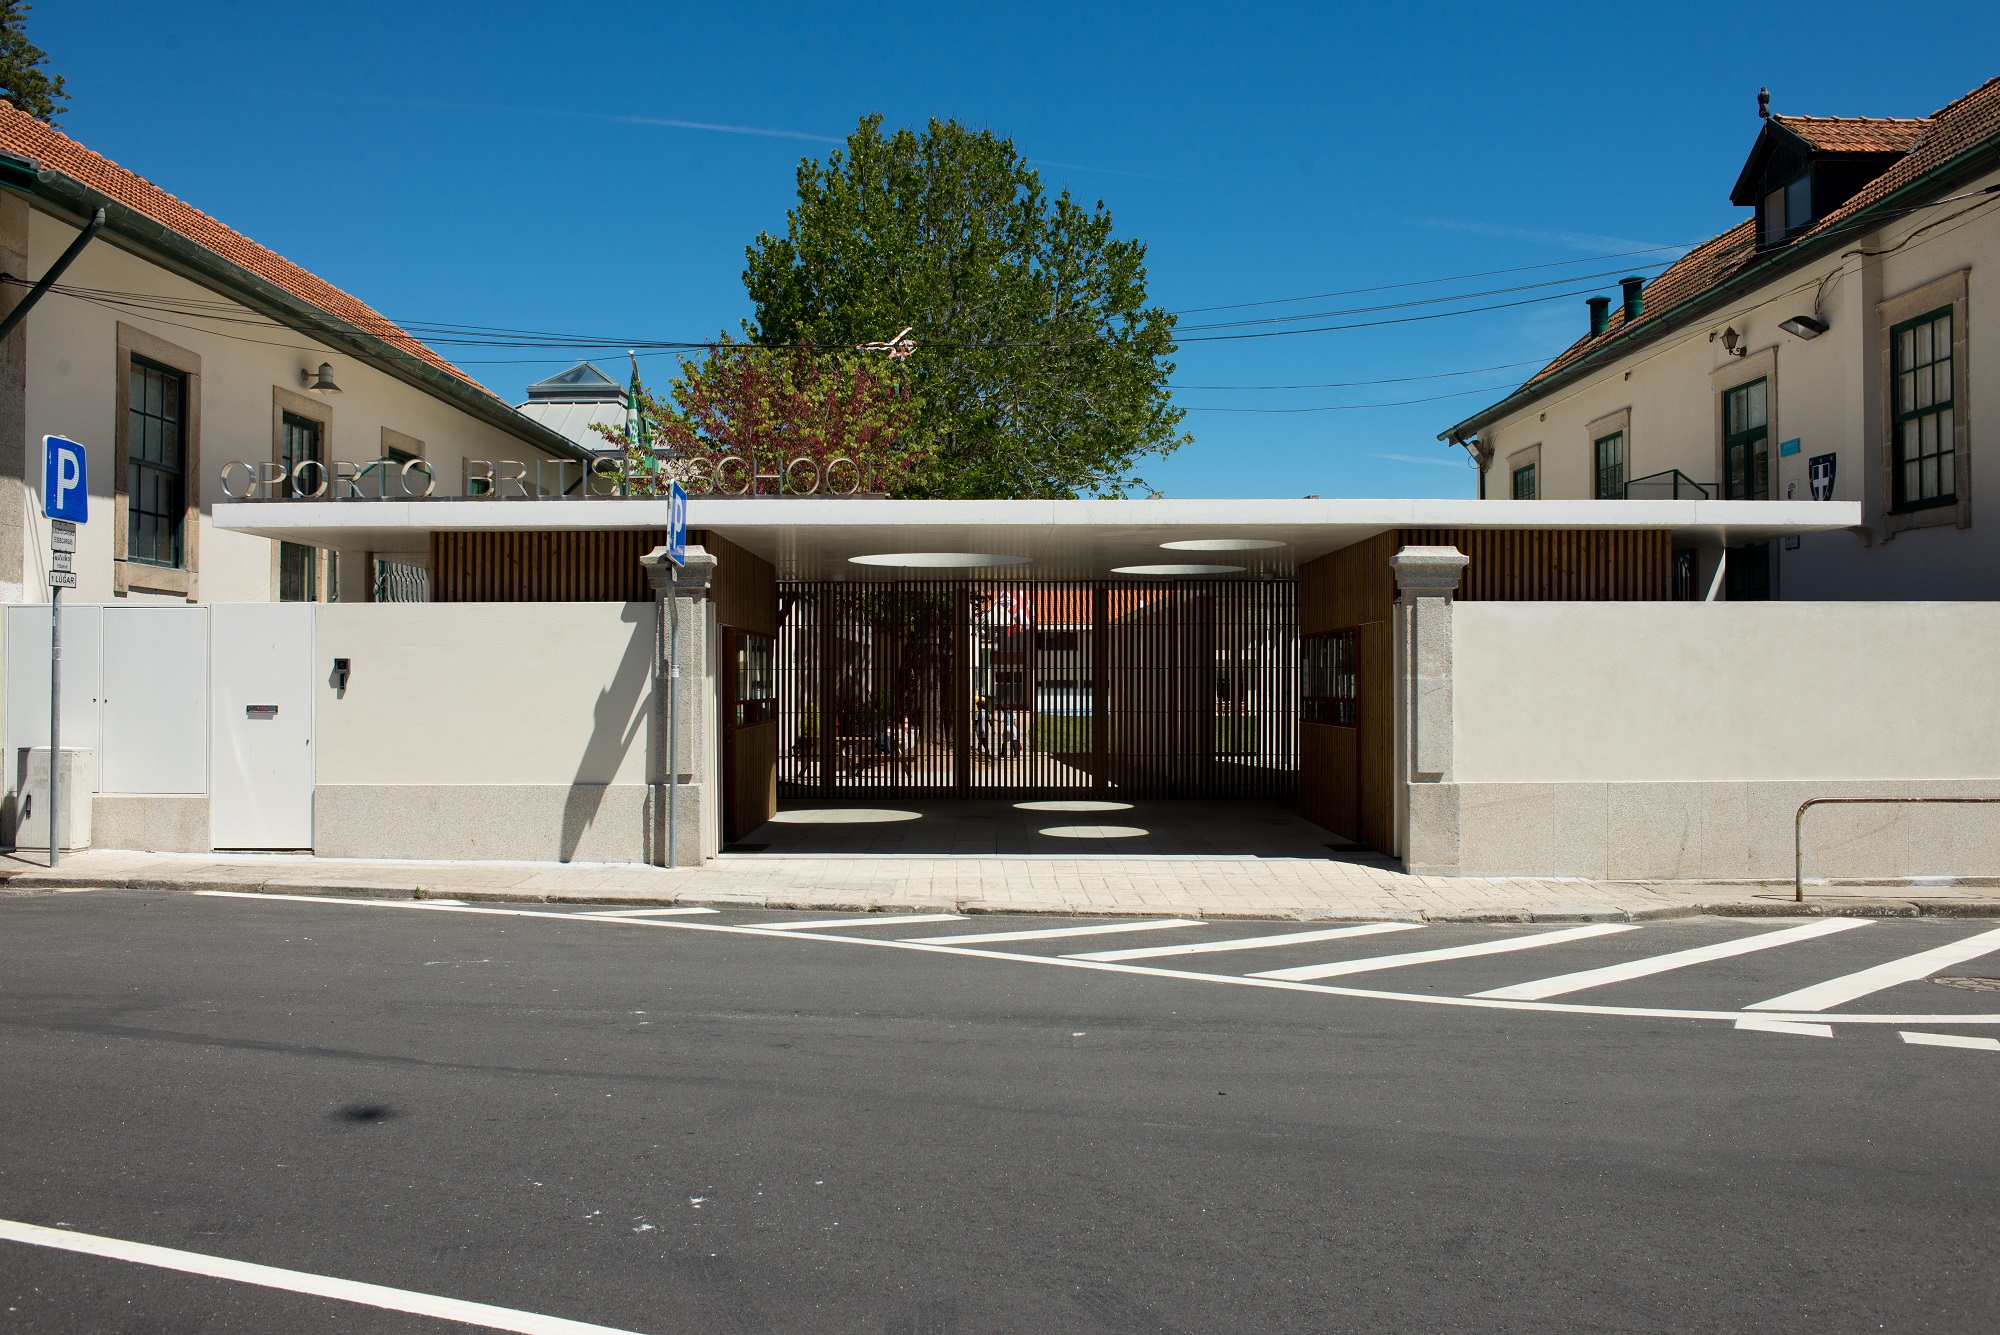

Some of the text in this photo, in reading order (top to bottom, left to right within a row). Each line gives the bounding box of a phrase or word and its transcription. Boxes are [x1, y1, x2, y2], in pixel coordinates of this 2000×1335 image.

[56, 448, 80, 510] P
[219, 456, 891, 499] OPORTO BRITISH SCHOOL
[673, 493, 683, 550] P
[55, 575, 75, 585] LUGAR
